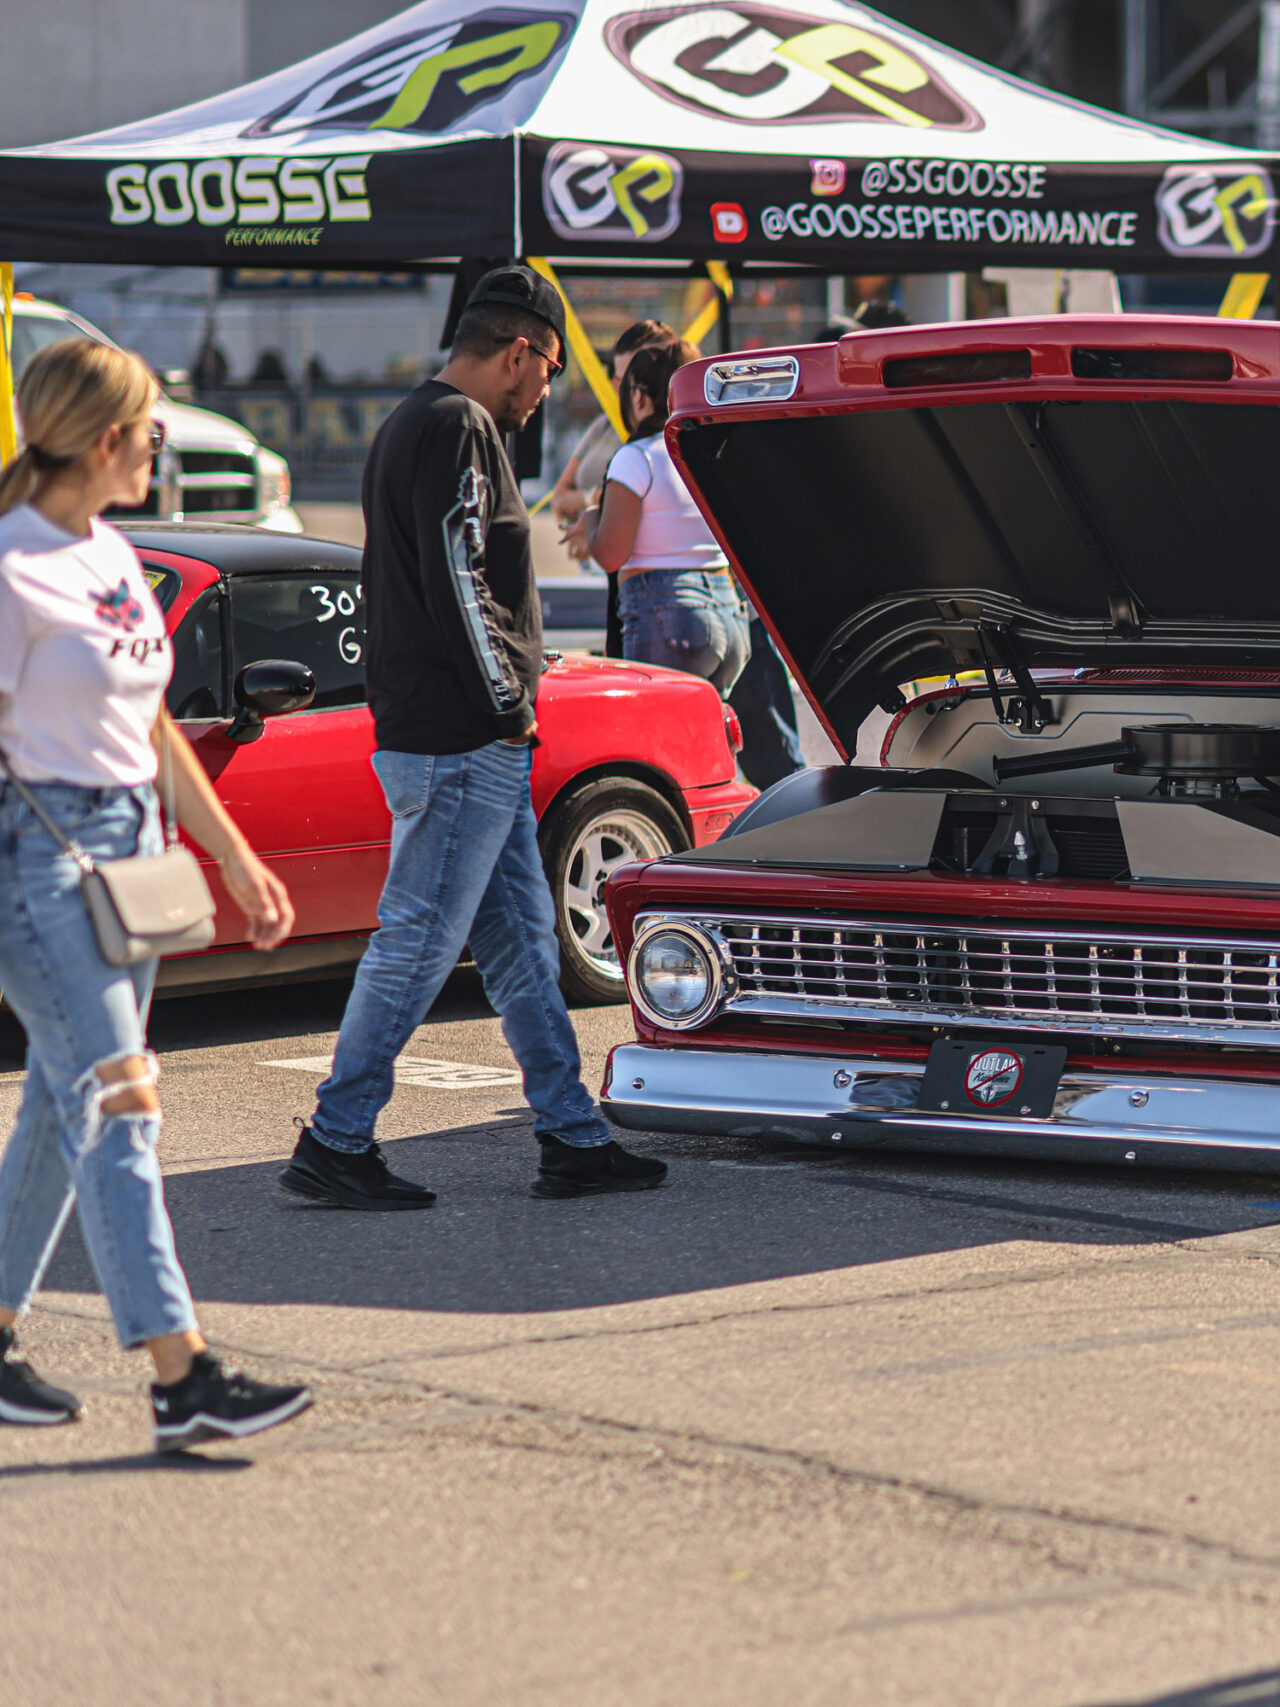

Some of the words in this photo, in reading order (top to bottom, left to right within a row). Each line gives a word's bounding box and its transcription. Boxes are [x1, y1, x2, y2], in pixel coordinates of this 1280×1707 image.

[106, 153, 373, 226] GOOSSE
[861, 159, 1047, 198] @SSGOOSSE
[225, 227, 324, 246] PERFORMANCE
[760, 203, 1137, 246] @GOOSSEPERFORMANCE
[310, 584, 364, 622] 30
[339, 626, 367, 665] G
